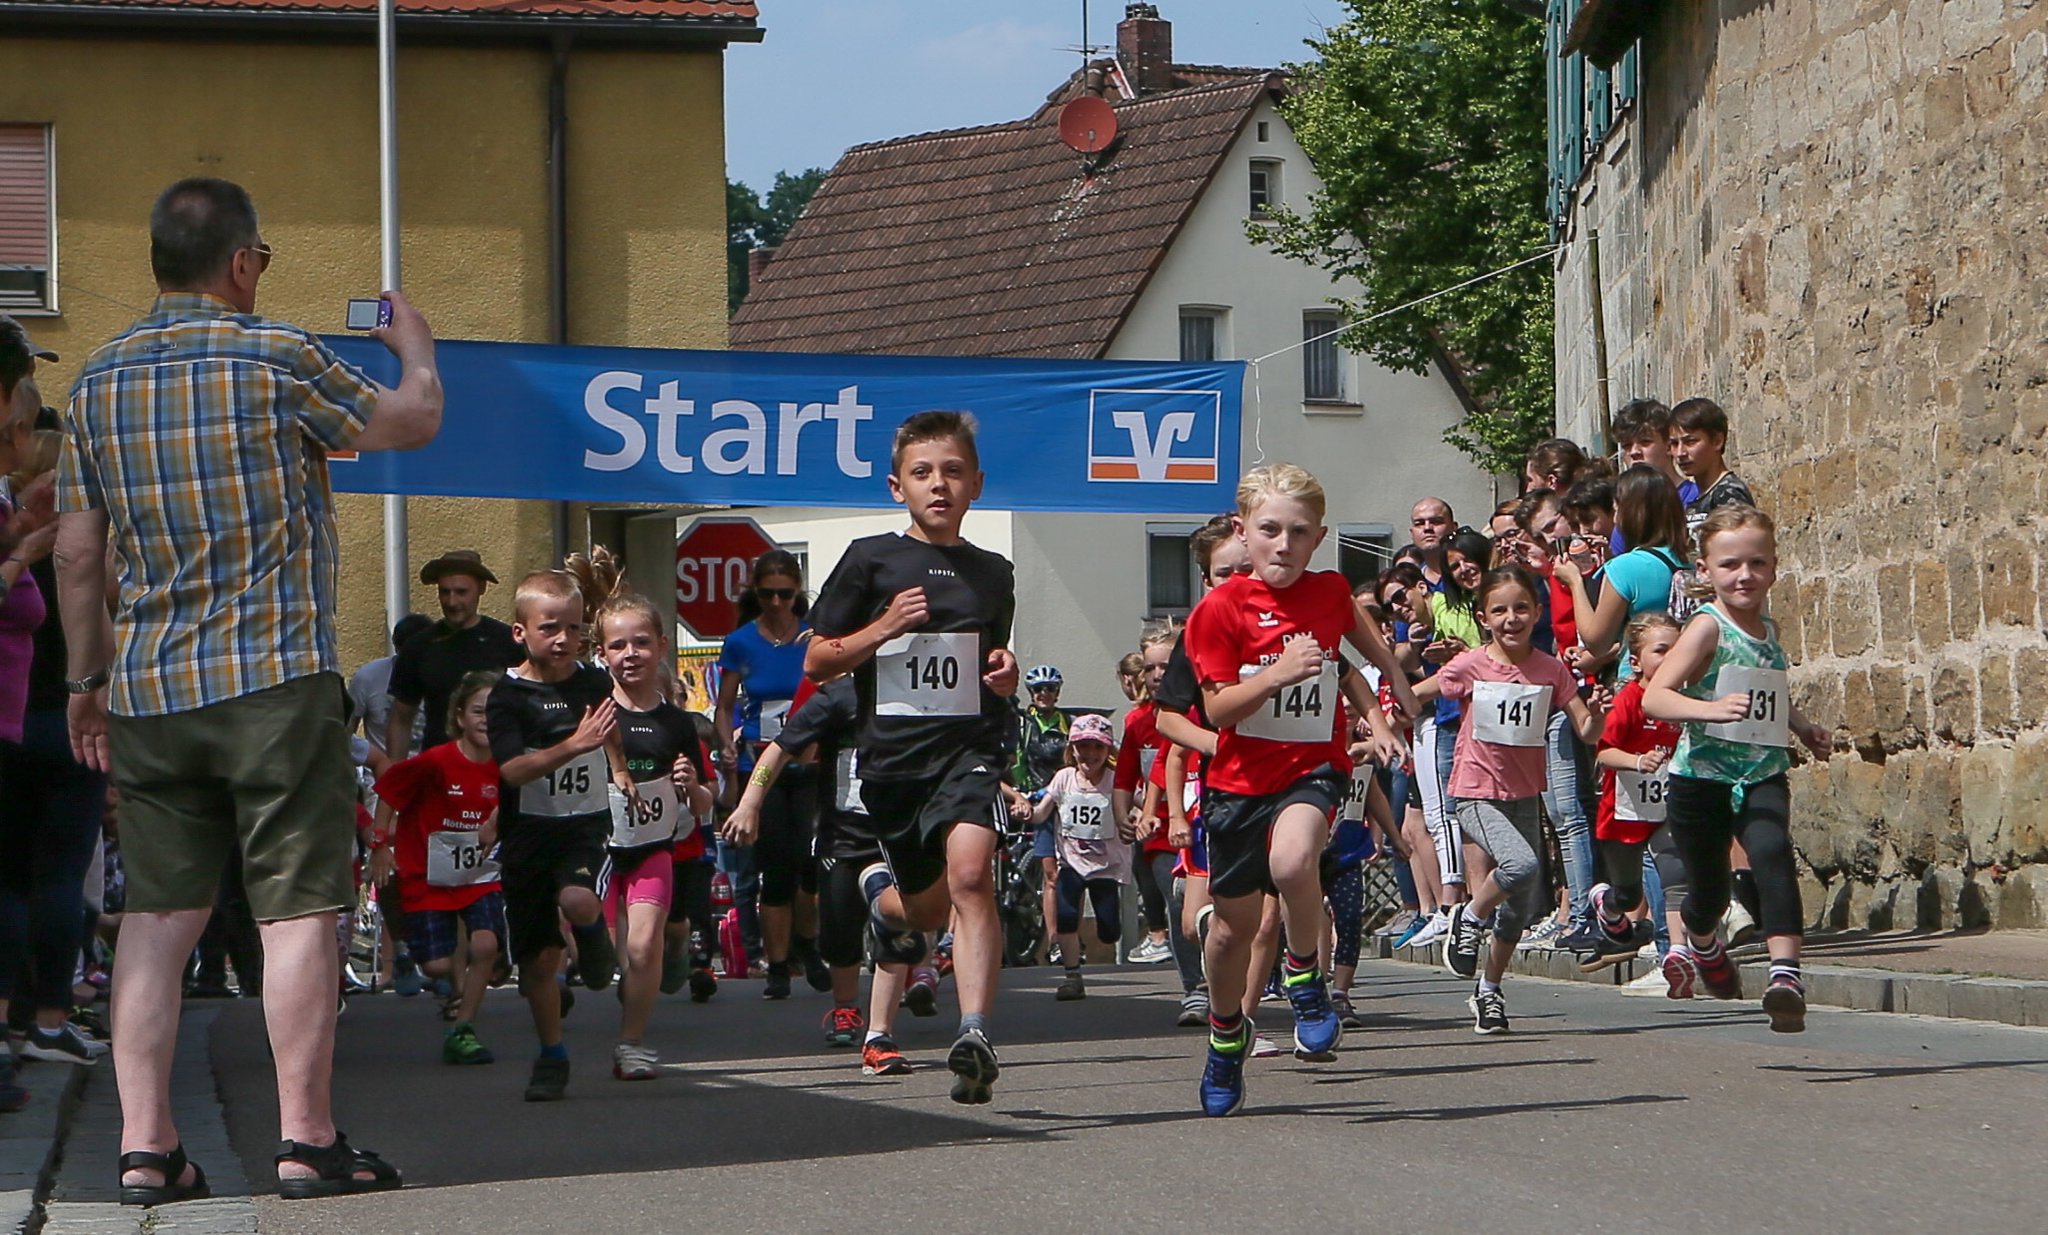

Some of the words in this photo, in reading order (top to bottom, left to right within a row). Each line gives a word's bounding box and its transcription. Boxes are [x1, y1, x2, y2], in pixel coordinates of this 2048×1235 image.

[583, 370, 873, 479] Start
[676, 557, 760, 603] STO
[905, 656, 959, 690] 140
[1269, 683, 1322, 718] 144
[1497, 700, 1532, 727] 141
[627, 759, 654, 770] ene
[545, 765, 590, 797] 145
[1348, 779, 1364, 802] 42
[1071, 806, 1101, 825] 152
